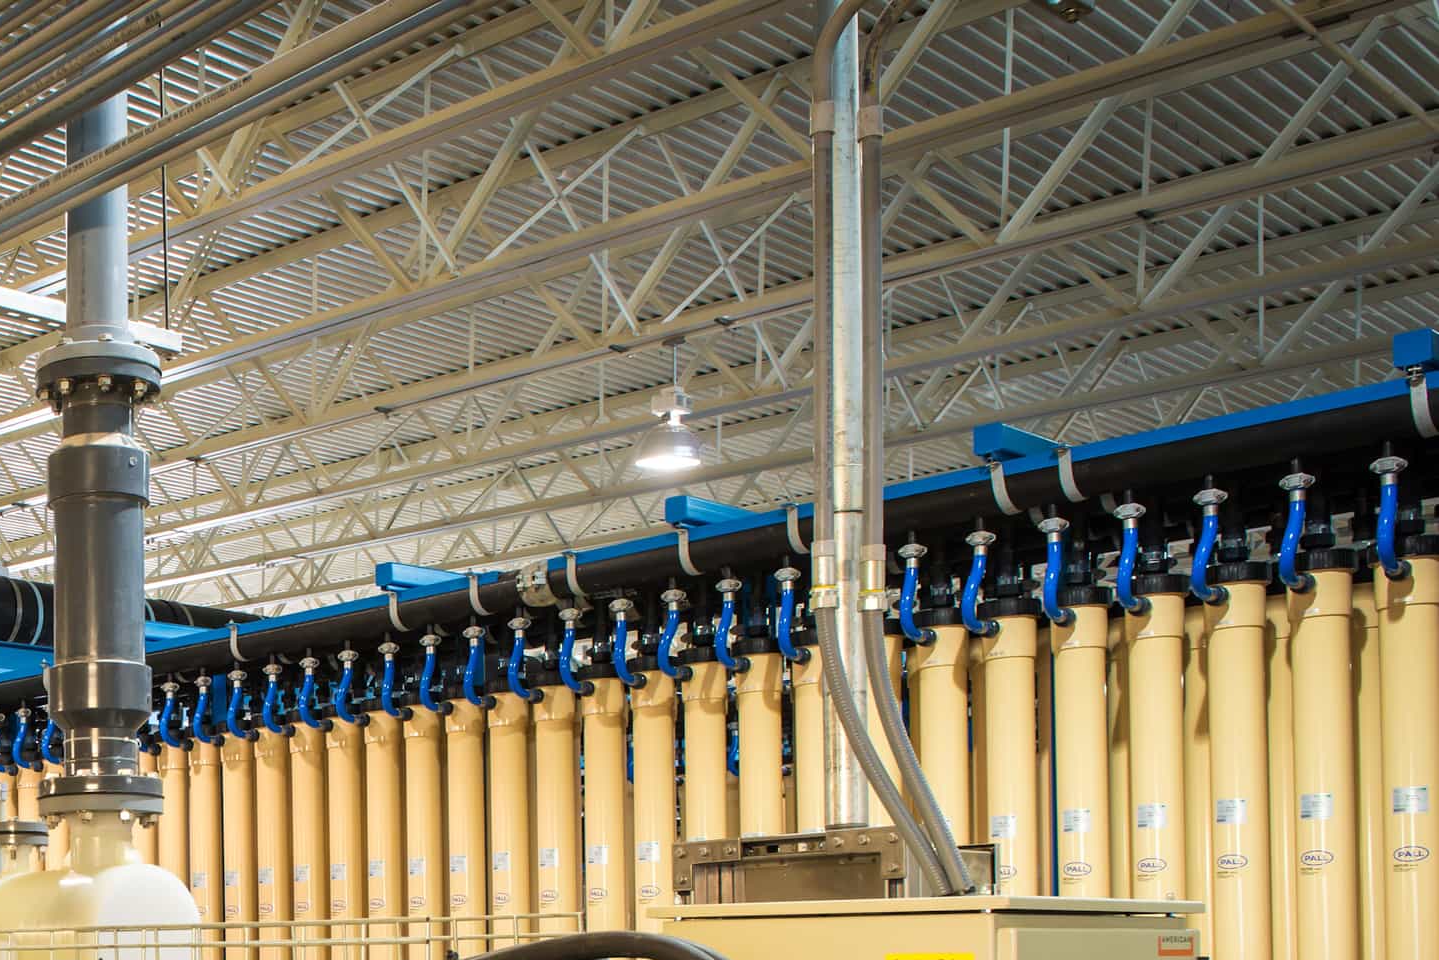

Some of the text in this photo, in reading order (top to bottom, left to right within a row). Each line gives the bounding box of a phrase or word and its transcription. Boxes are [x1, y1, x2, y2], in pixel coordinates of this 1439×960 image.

[1304, 853, 1329, 862] PALL
[1398, 849, 1426, 858] PALL
[1140, 861, 1164, 869] PALL
[1219, 858, 1243, 866] PALL
[1066, 865, 1088, 873] PALL
